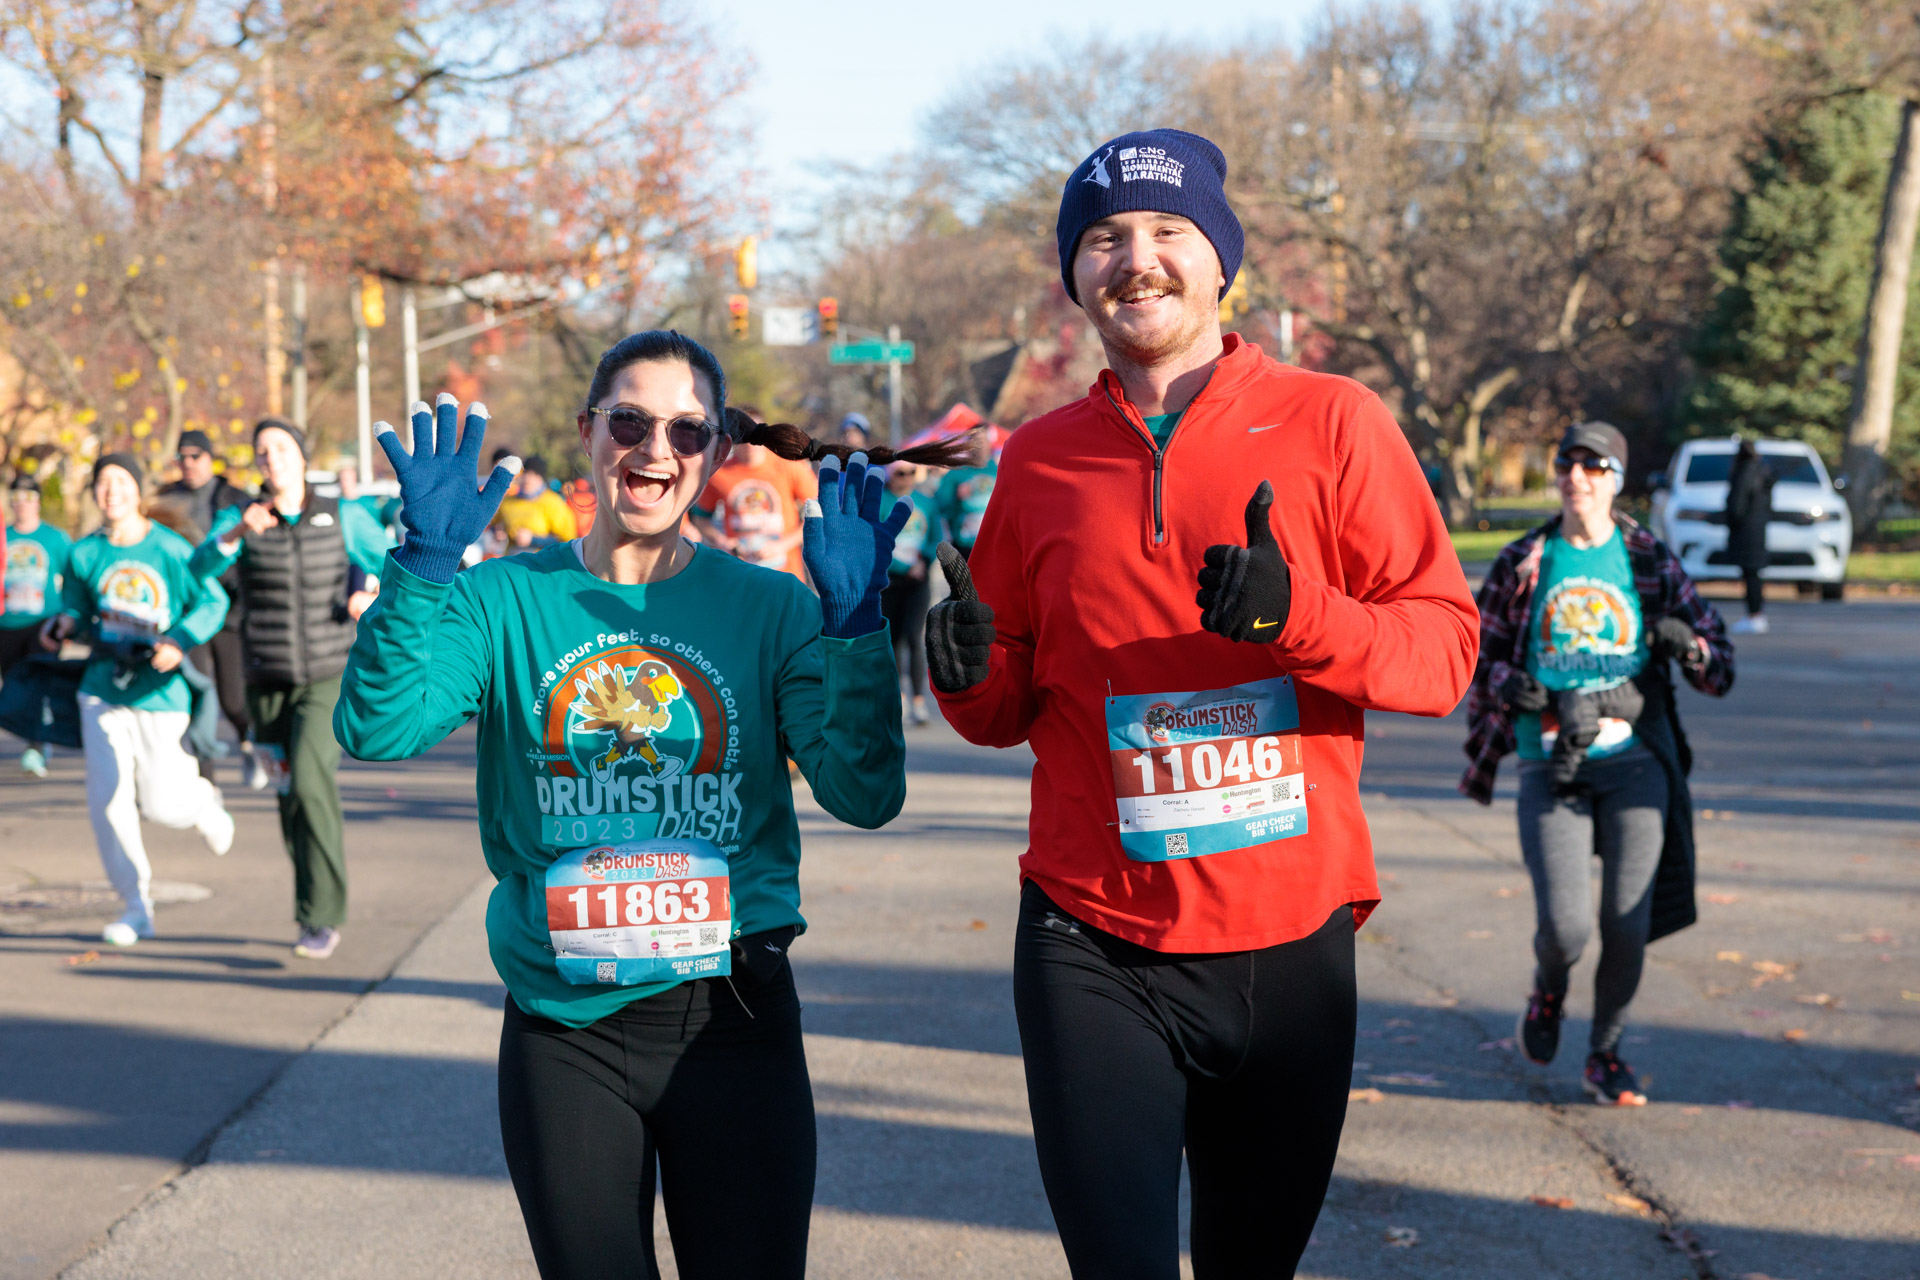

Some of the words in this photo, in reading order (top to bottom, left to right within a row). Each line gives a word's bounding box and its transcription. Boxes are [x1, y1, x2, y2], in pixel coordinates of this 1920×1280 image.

[1139, 146, 1166, 156] CNO
[1121, 163, 1183, 179] MONUMENTAL
[1123, 170, 1182, 187] MARATHON
[532, 670, 557, 716] move
[554, 641, 593, 673] your
[596, 628, 644, 649] feet,
[649, 633, 671, 647] so
[674, 642, 724, 686] others
[720, 687, 739, 720] can
[1165, 702, 1258, 730] DRUMSTICK
[1174, 726, 1213, 740] 2023
[1221, 719, 1258, 736] DASH
[546, 753, 571, 761] MISSION
[1132, 735, 1283, 794] 11046
[535, 772, 744, 817] DRUMSTICK
[1229, 787, 1262, 797] Huntington
[553, 817, 636, 842] 2023
[656, 806, 743, 842] DASH
[1245, 820, 1268, 831] GEAR
[1268, 813, 1297, 826] CHECK
[1251, 829, 1266, 838] BIB
[1269, 822, 1294, 834] 11046
[604, 852, 690, 870] DRUMSTICK
[611, 869, 648, 880] 2023
[655, 864, 689, 879] DASH
[568, 880, 710, 928] 11863
[658, 928, 690, 936] Huntington
[671, 960, 694, 970] GEAR
[694, 955, 721, 966] CHECK
[676, 967, 691, 975] BIB
